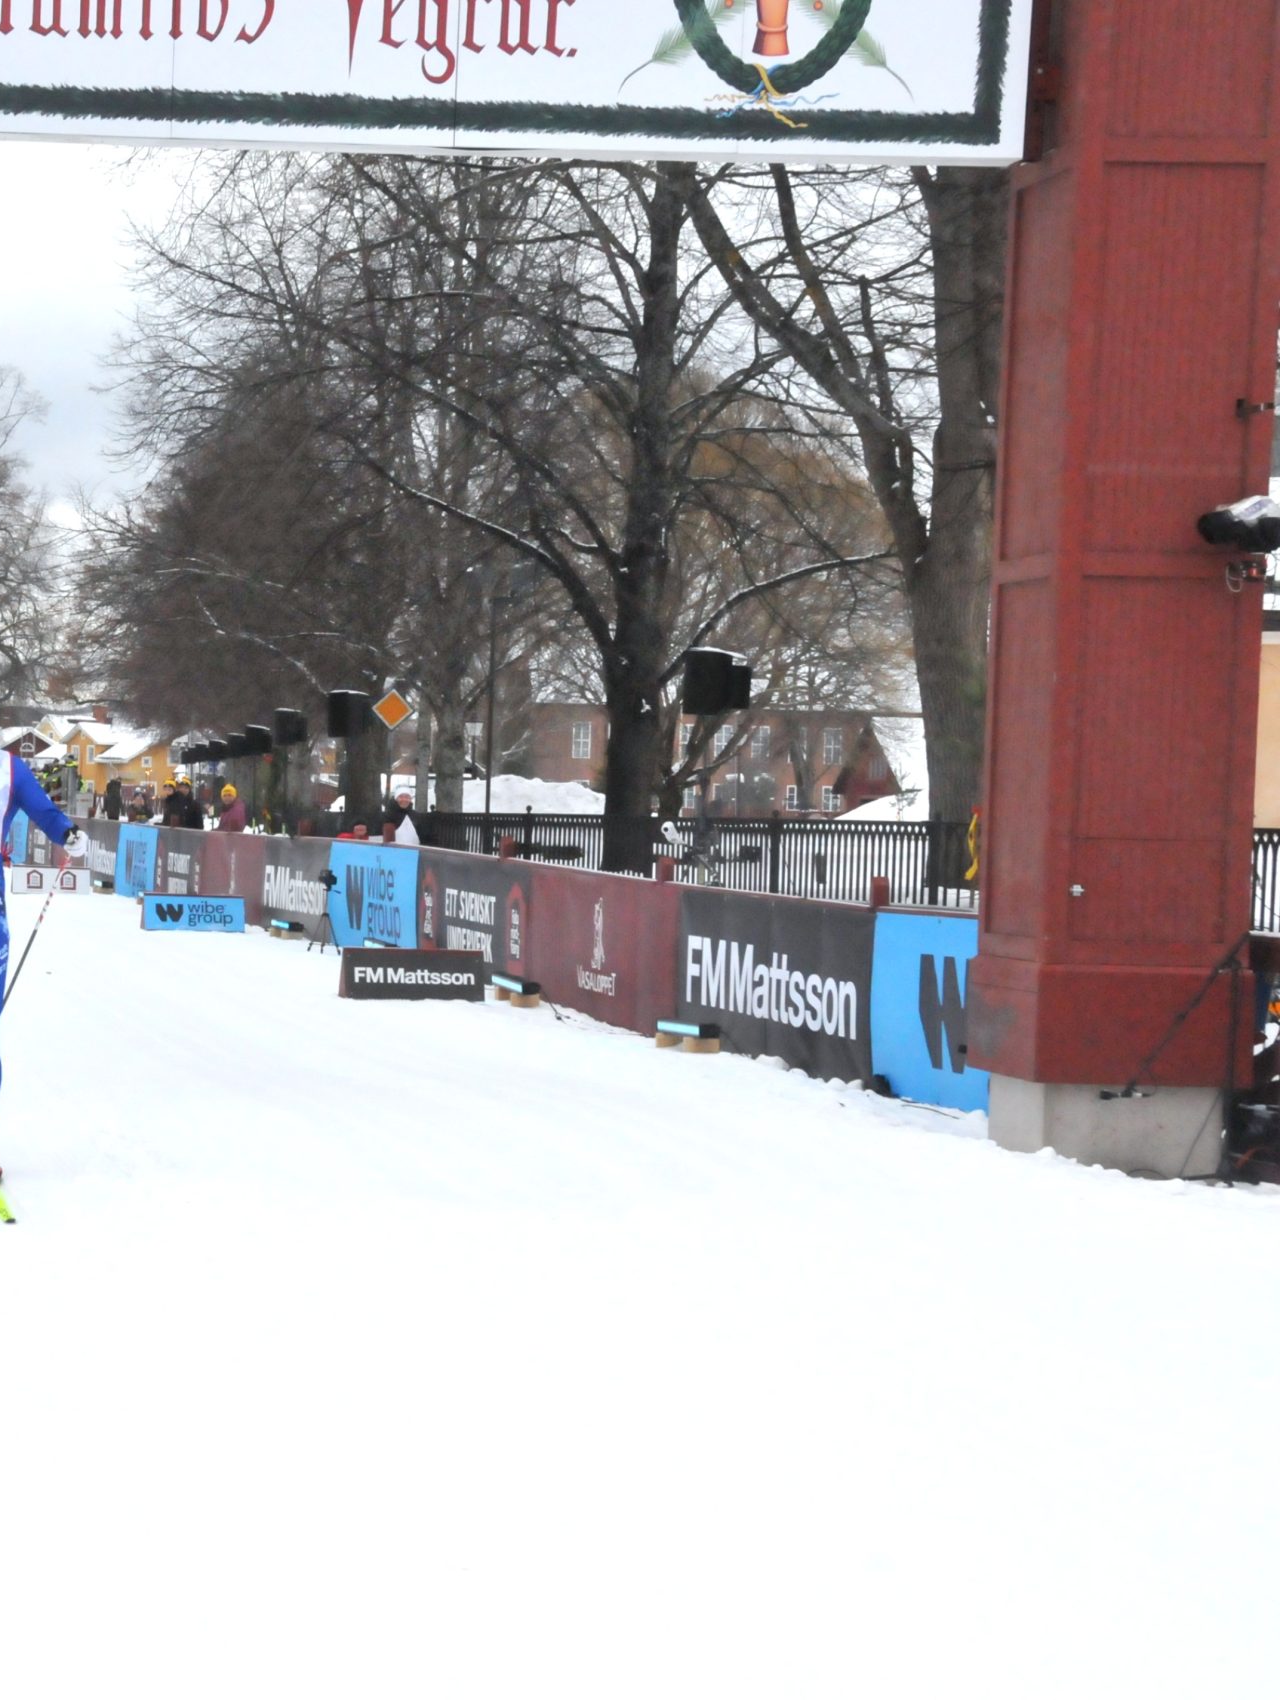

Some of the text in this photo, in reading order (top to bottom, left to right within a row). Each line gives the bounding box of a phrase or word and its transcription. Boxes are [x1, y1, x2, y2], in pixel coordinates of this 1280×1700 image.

[367, 855, 395, 902] wibe
[188, 901, 224, 914] wibe
[188, 913, 233, 927] group
[367, 902, 401, 943] group
[445, 888, 458, 918] ETT
[459, 890, 496, 926] SVENSKT
[354, 967, 475, 986] FM Mattsson
[576, 964, 617, 997] VASALOPPET
[686, 935, 857, 1040] FM Mattsson
